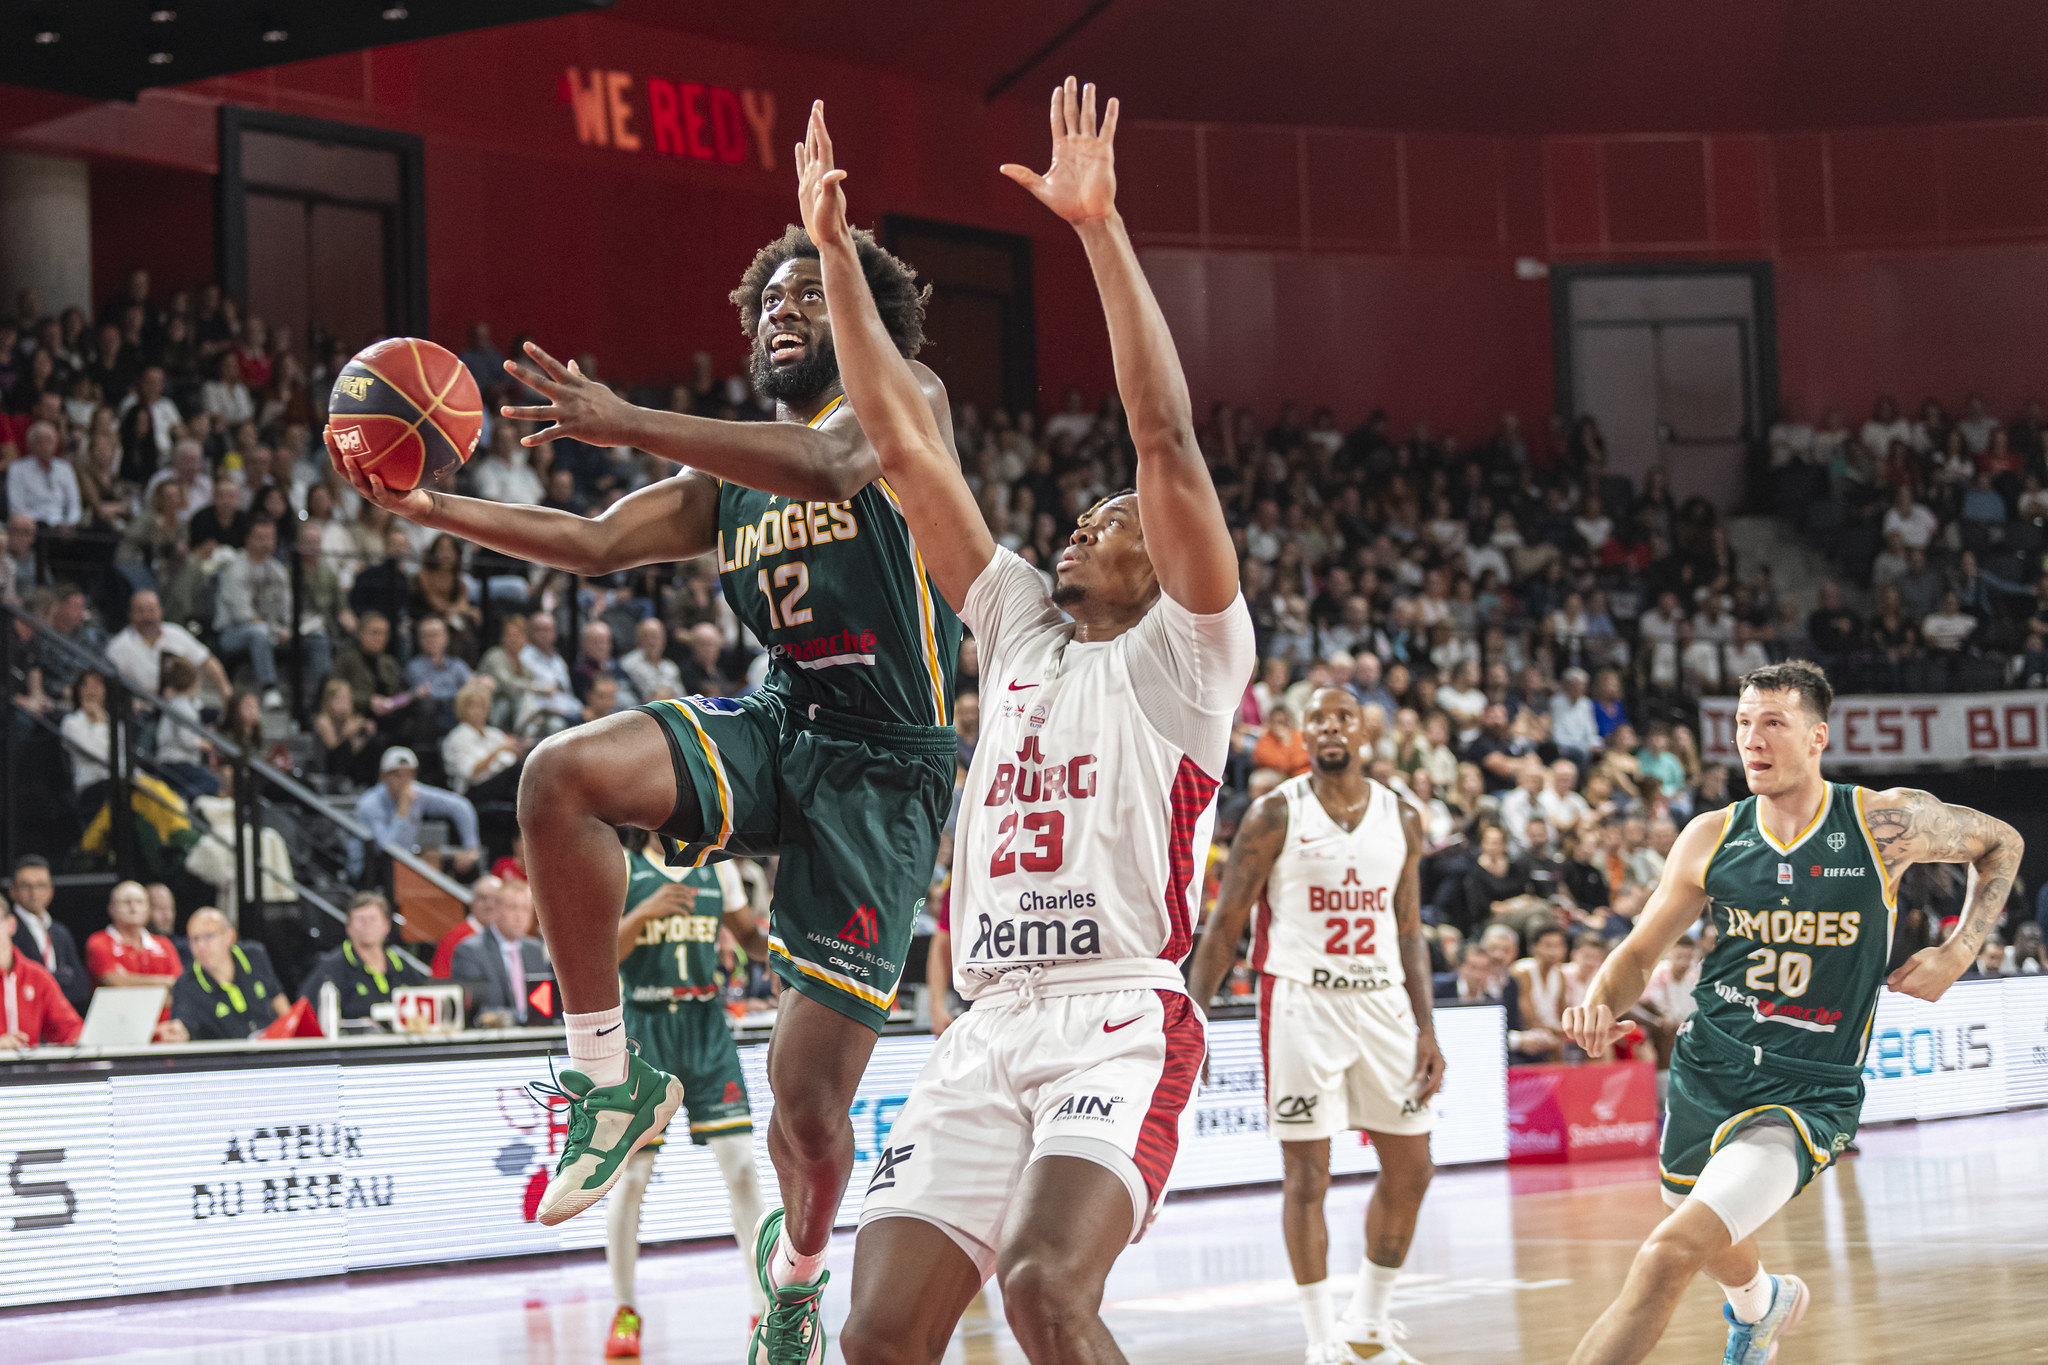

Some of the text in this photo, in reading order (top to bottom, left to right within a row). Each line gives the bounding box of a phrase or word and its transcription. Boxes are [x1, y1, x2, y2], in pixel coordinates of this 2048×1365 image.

[567, 67, 641, 150] WE
[717, 499, 858, 574] LIMOGES
[758, 560, 813, 630] 12
[1967, 704, 2048, 750] BO
[984, 754, 1097, 807] BOURG
[990, 810, 1065, 878] 23
[1823, 867, 1866, 877] EIFFAGE
[1019, 889, 1096, 911] Charles
[1309, 886, 1388, 912] BOURG
[1325, 917, 1375, 955] 22
[1723, 906, 1861, 946] LIMOGES
[674, 943, 688, 981] 1
[806, 932, 896, 974] MAISONS ARLOGIS
[828, 956, 863, 974] CRAFT
[1745, 947, 1812, 998] 20
[1051, 1095, 1112, 1120] AIN
[221, 1124, 363, 1165] ACTEUR
[193, 1166, 394, 1220] DU RÉSEAU
